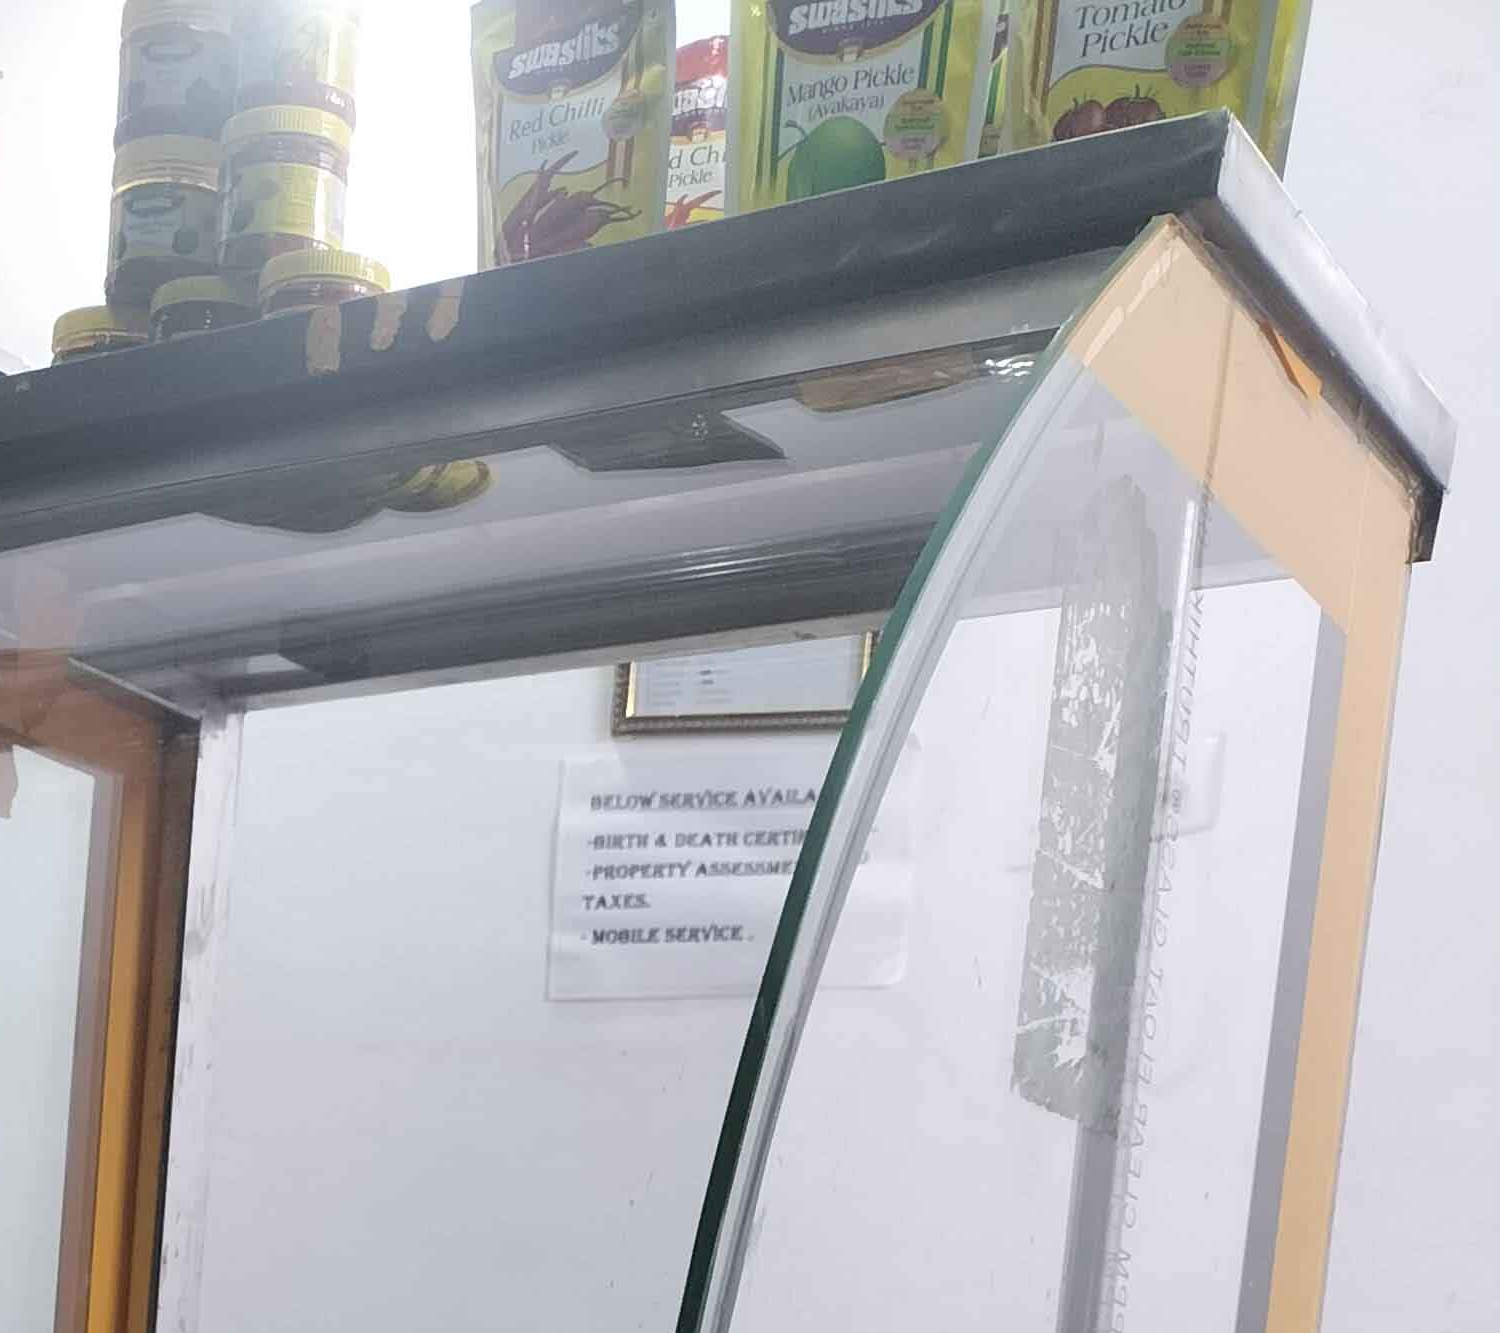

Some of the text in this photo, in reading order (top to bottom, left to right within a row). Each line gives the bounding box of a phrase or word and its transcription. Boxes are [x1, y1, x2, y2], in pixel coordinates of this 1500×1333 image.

[1080, 20, 1169, 58] Pickle
[787, 63, 916, 107] Mango Pickle
[509, 97, 606, 143] Red Chilli
[742, 786, 817, 807] AVAILA
[695, 859, 793, 877] ASSESSME
